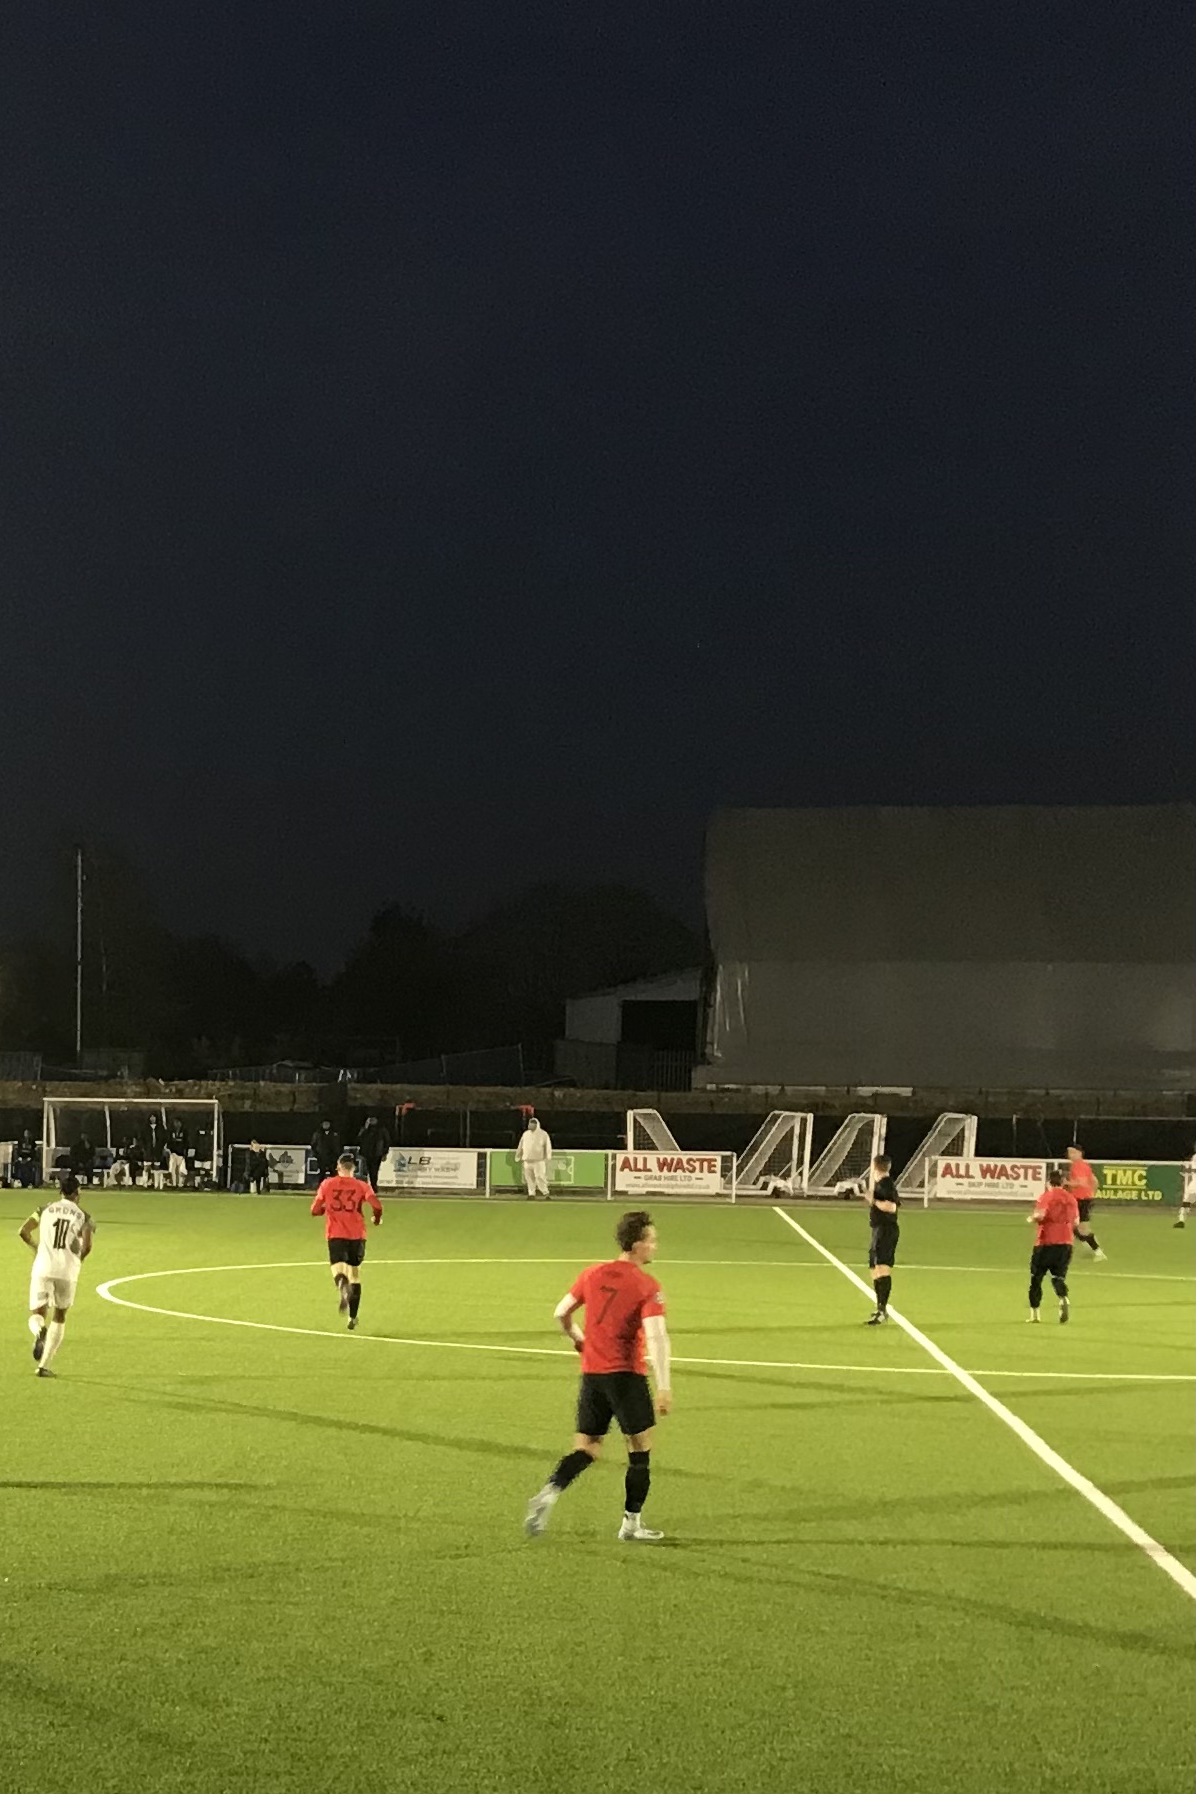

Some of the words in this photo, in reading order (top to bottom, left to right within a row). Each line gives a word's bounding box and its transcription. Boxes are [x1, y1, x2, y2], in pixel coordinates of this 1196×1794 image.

[619, 1156, 652, 1172] ALL
[656, 1157, 718, 1174] WASTE
[941, 1162, 975, 1179] ALL
[979, 1163, 1043, 1181] WASTE
[1103, 1169, 1147, 1186] TMC
[330, 1189, 356, 1212] 33
[1094, 1188, 1139, 1200] AULAGE
[1141, 1190, 1163, 1201] LTD
[52, 1217, 71, 1249] 10
[596, 1285, 620, 1325] 7
